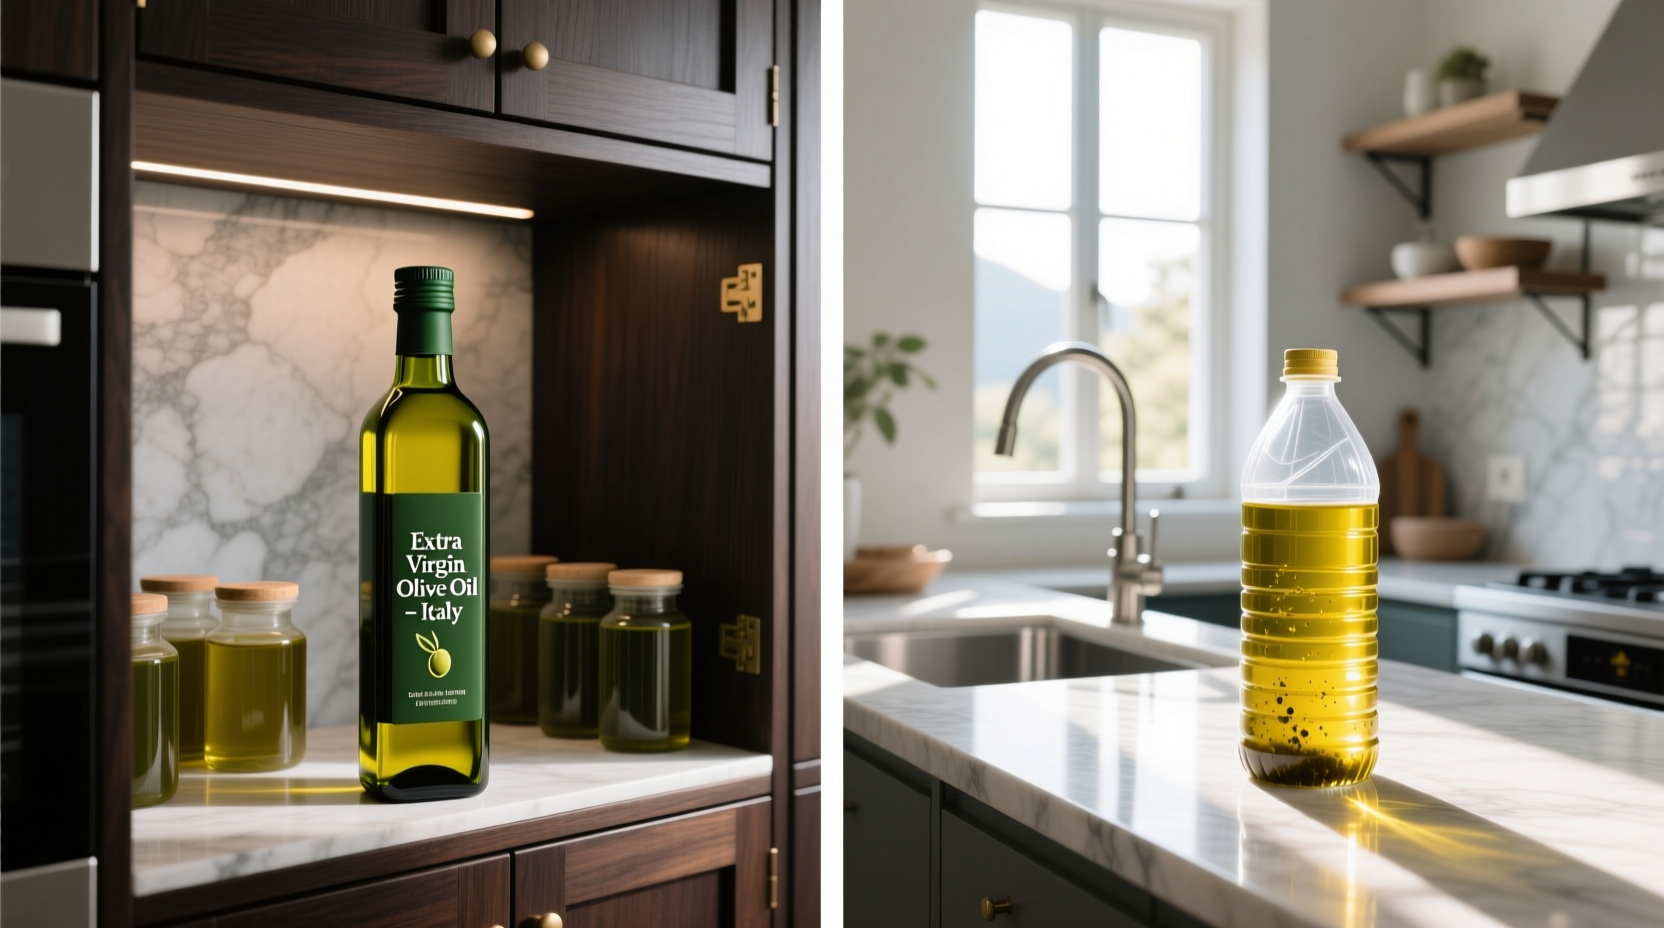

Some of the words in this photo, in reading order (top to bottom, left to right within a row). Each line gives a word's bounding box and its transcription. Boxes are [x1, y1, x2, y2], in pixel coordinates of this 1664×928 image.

[410, 531, 462, 551] Extra
[406, 554, 467, 579] Virgin
[396, 577, 448, 598] Olive
[449, 576, 478, 597] Oil
[421, 601, 464, 626] Italy
